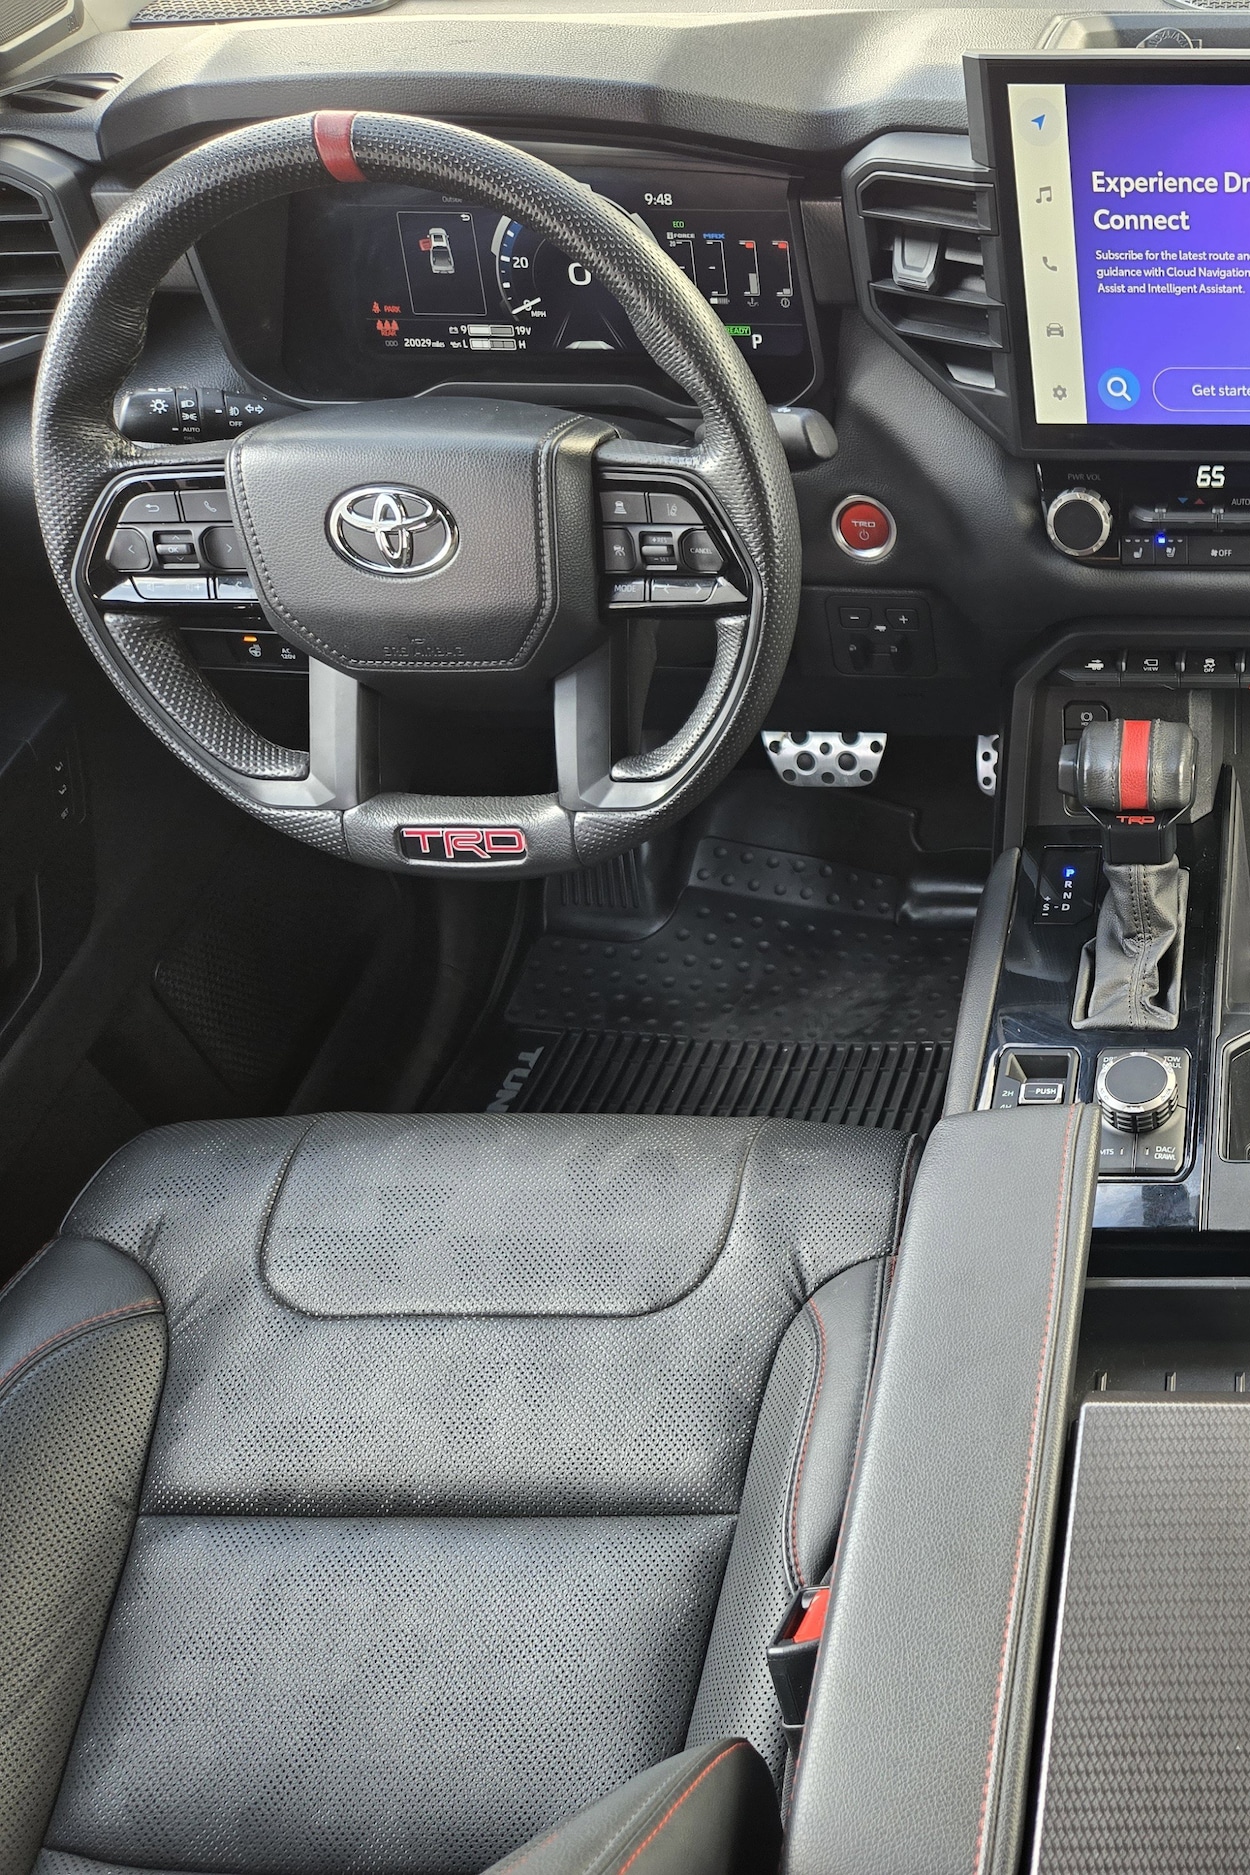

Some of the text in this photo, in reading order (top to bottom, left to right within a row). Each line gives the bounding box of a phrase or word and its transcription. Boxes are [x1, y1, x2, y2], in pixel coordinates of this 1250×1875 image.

[1091, 170, 1219, 198] Experience
[644, 192, 673, 206] 9:48
[1093, 208, 1190, 230] Connect
[672, 220, 685, 228] ECO
[1095, 250, 1143, 261] Subscribe
[1145, 250, 1160, 261] for
[1160, 250, 1178, 261] the
[1179, 250, 1206, 261] latest
[1208, 251, 1235, 261] route
[512, 257, 529, 269] 20
[1096, 267, 1142, 279] guidance
[1143, 267, 1165, 278] with
[1166, 267, 1196, 278] Cloud
[1097, 283, 1246, 295] Assist and Intelligent Assistant.
[531, 310, 546, 318] MPH
[460, 326, 467, 334] 9
[404, 338, 431, 347] 20029
[518, 341, 526, 349] H
[752, 334, 763, 349] P
[1191, 384, 1216, 397] Get
[1067, 473, 1101, 481] PWR VOL
[1196, 465, 1225, 488] 65
[1231, 498, 1250, 506] AUTO
[851, 520, 876, 528] TRD
[1218, 549, 1233, 557] OFF
[1116, 815, 1155, 825] TRD
[401, 828, 526, 859] TRD
[1066, 869, 1075, 877] P
[1064, 880, 1072, 888] R
[1035, 1087, 1056, 1095] PUSH
[1155, 1145, 1176, 1154] DAC/
